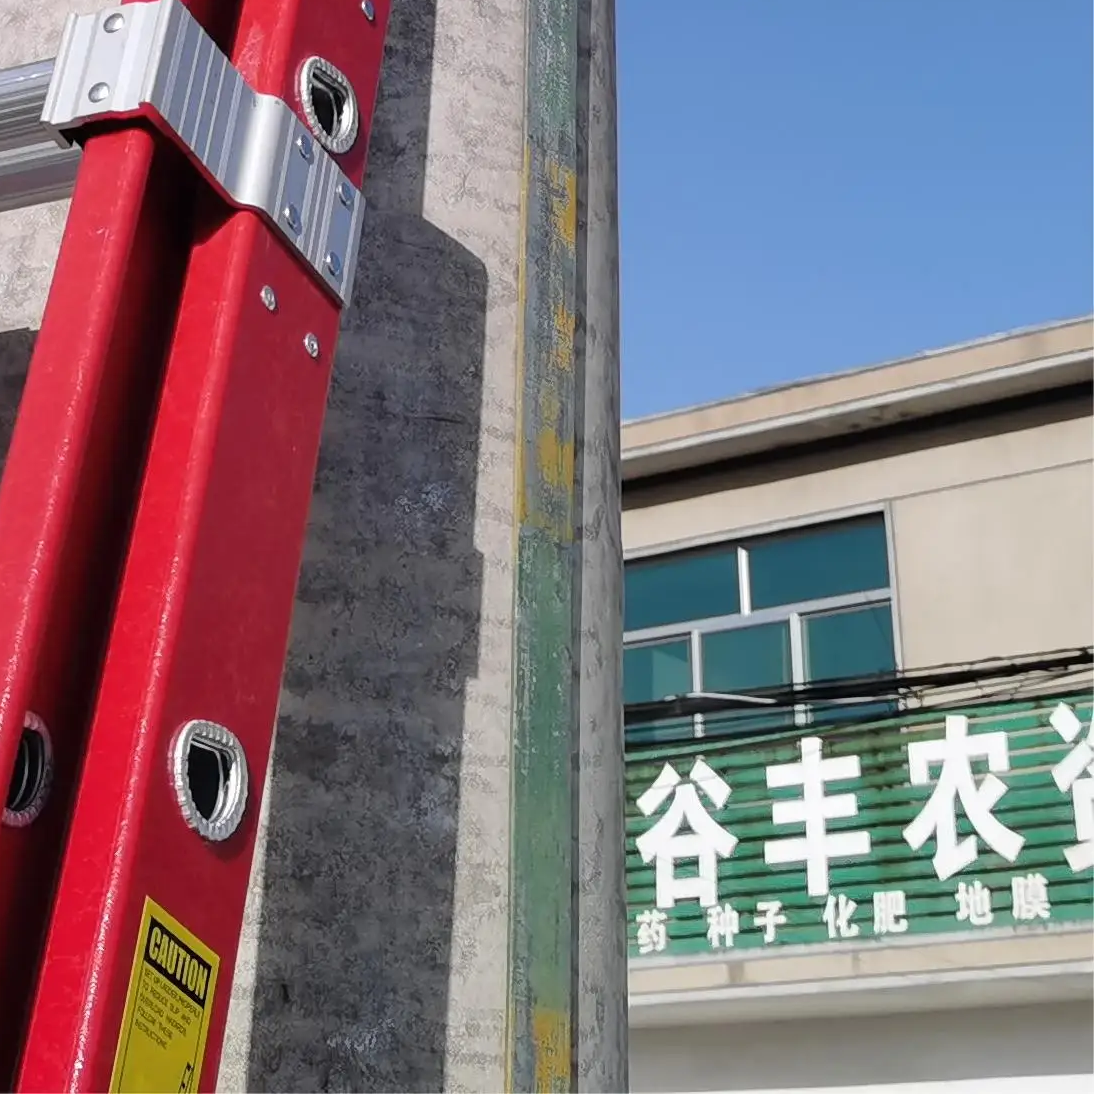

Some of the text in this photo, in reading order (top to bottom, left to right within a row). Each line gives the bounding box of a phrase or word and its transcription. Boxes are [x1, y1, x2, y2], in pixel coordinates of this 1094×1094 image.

[707, 902, 787, 948] 种子
[822, 892, 908, 939] 化肥
[954, 872, 1051, 926] 地膜
[148, 926, 209, 1001] CAUTION
